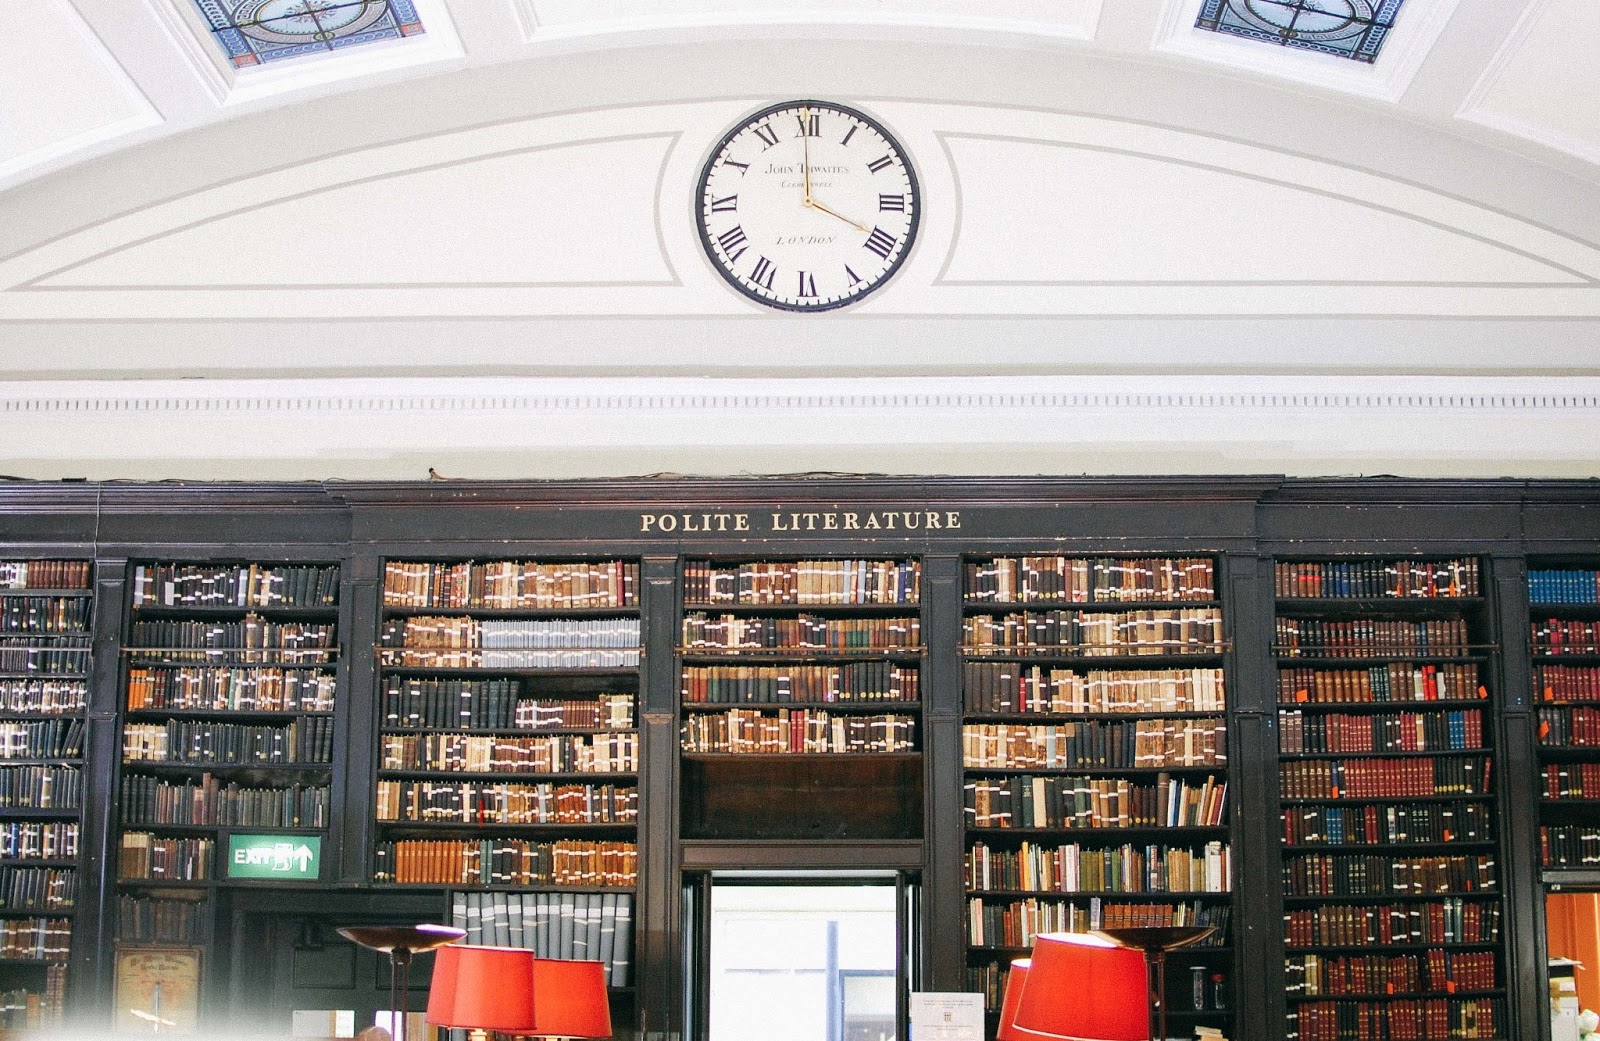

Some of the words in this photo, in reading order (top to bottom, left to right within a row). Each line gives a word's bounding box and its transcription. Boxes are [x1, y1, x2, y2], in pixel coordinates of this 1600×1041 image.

[776, 236, 837, 245] LONDON
[640, 514, 750, 532] POLITE
[771, 511, 961, 531] LITERATURE
[234, 847, 273, 865] EXIT
